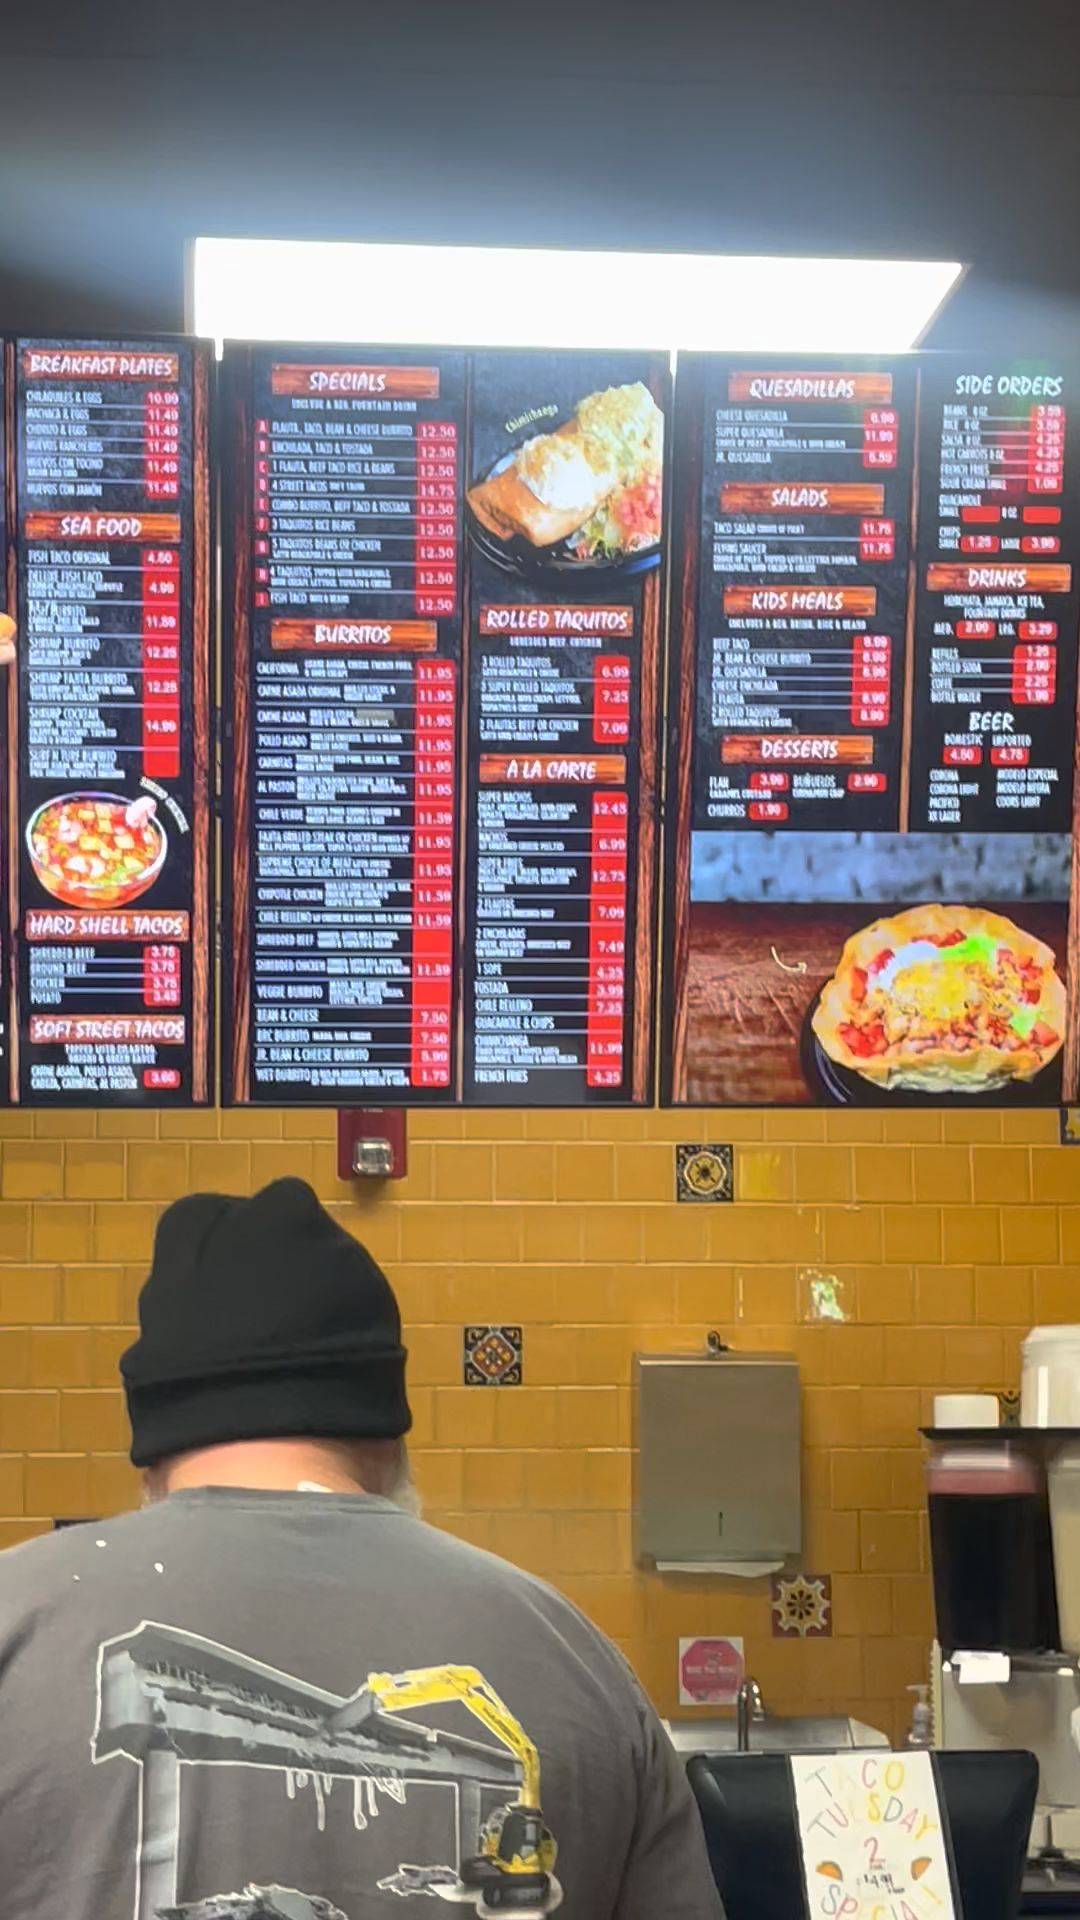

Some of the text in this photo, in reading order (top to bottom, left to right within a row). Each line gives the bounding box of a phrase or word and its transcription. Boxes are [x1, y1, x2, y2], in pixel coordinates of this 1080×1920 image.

[30, 354, 172, 376] BREAKFAST PLATES
[309, 372, 387, 392] SPECIALS
[750, 378, 856, 398] QUESADILLAS
[955, 375, 1063, 396] SIDE ORDERS
[421, 426, 455, 438] 12.50
[421, 446, 455, 458] 12.50
[420, 465, 454, 476] 12.50
[771, 488, 828, 506] SALADS
[420, 502, 454, 514] 12.50
[61, 516, 142, 537] SEA FOOD
[420, 525, 454, 536] 12.50
[420, 548, 454, 559] 12.50
[419, 572, 453, 584] 12.50
[968, 568, 1027, 588] DRINKS
[419, 600, 453, 611] 12.50
[752, 592, 844, 611] KIDS MEALS
[486, 609, 628, 631] ROLLED TAQUITOS
[315, 624, 393, 644] BURRITOS
[969, 711, 1015, 732] BEER
[761, 739, 839, 759] DESSERTS
[506, 760, 597, 780] A LA CARTE
[30, 915, 183, 935] HARD SHELL TACOS
[34, 1020, 185, 1039] SOFT STREET TACOS
